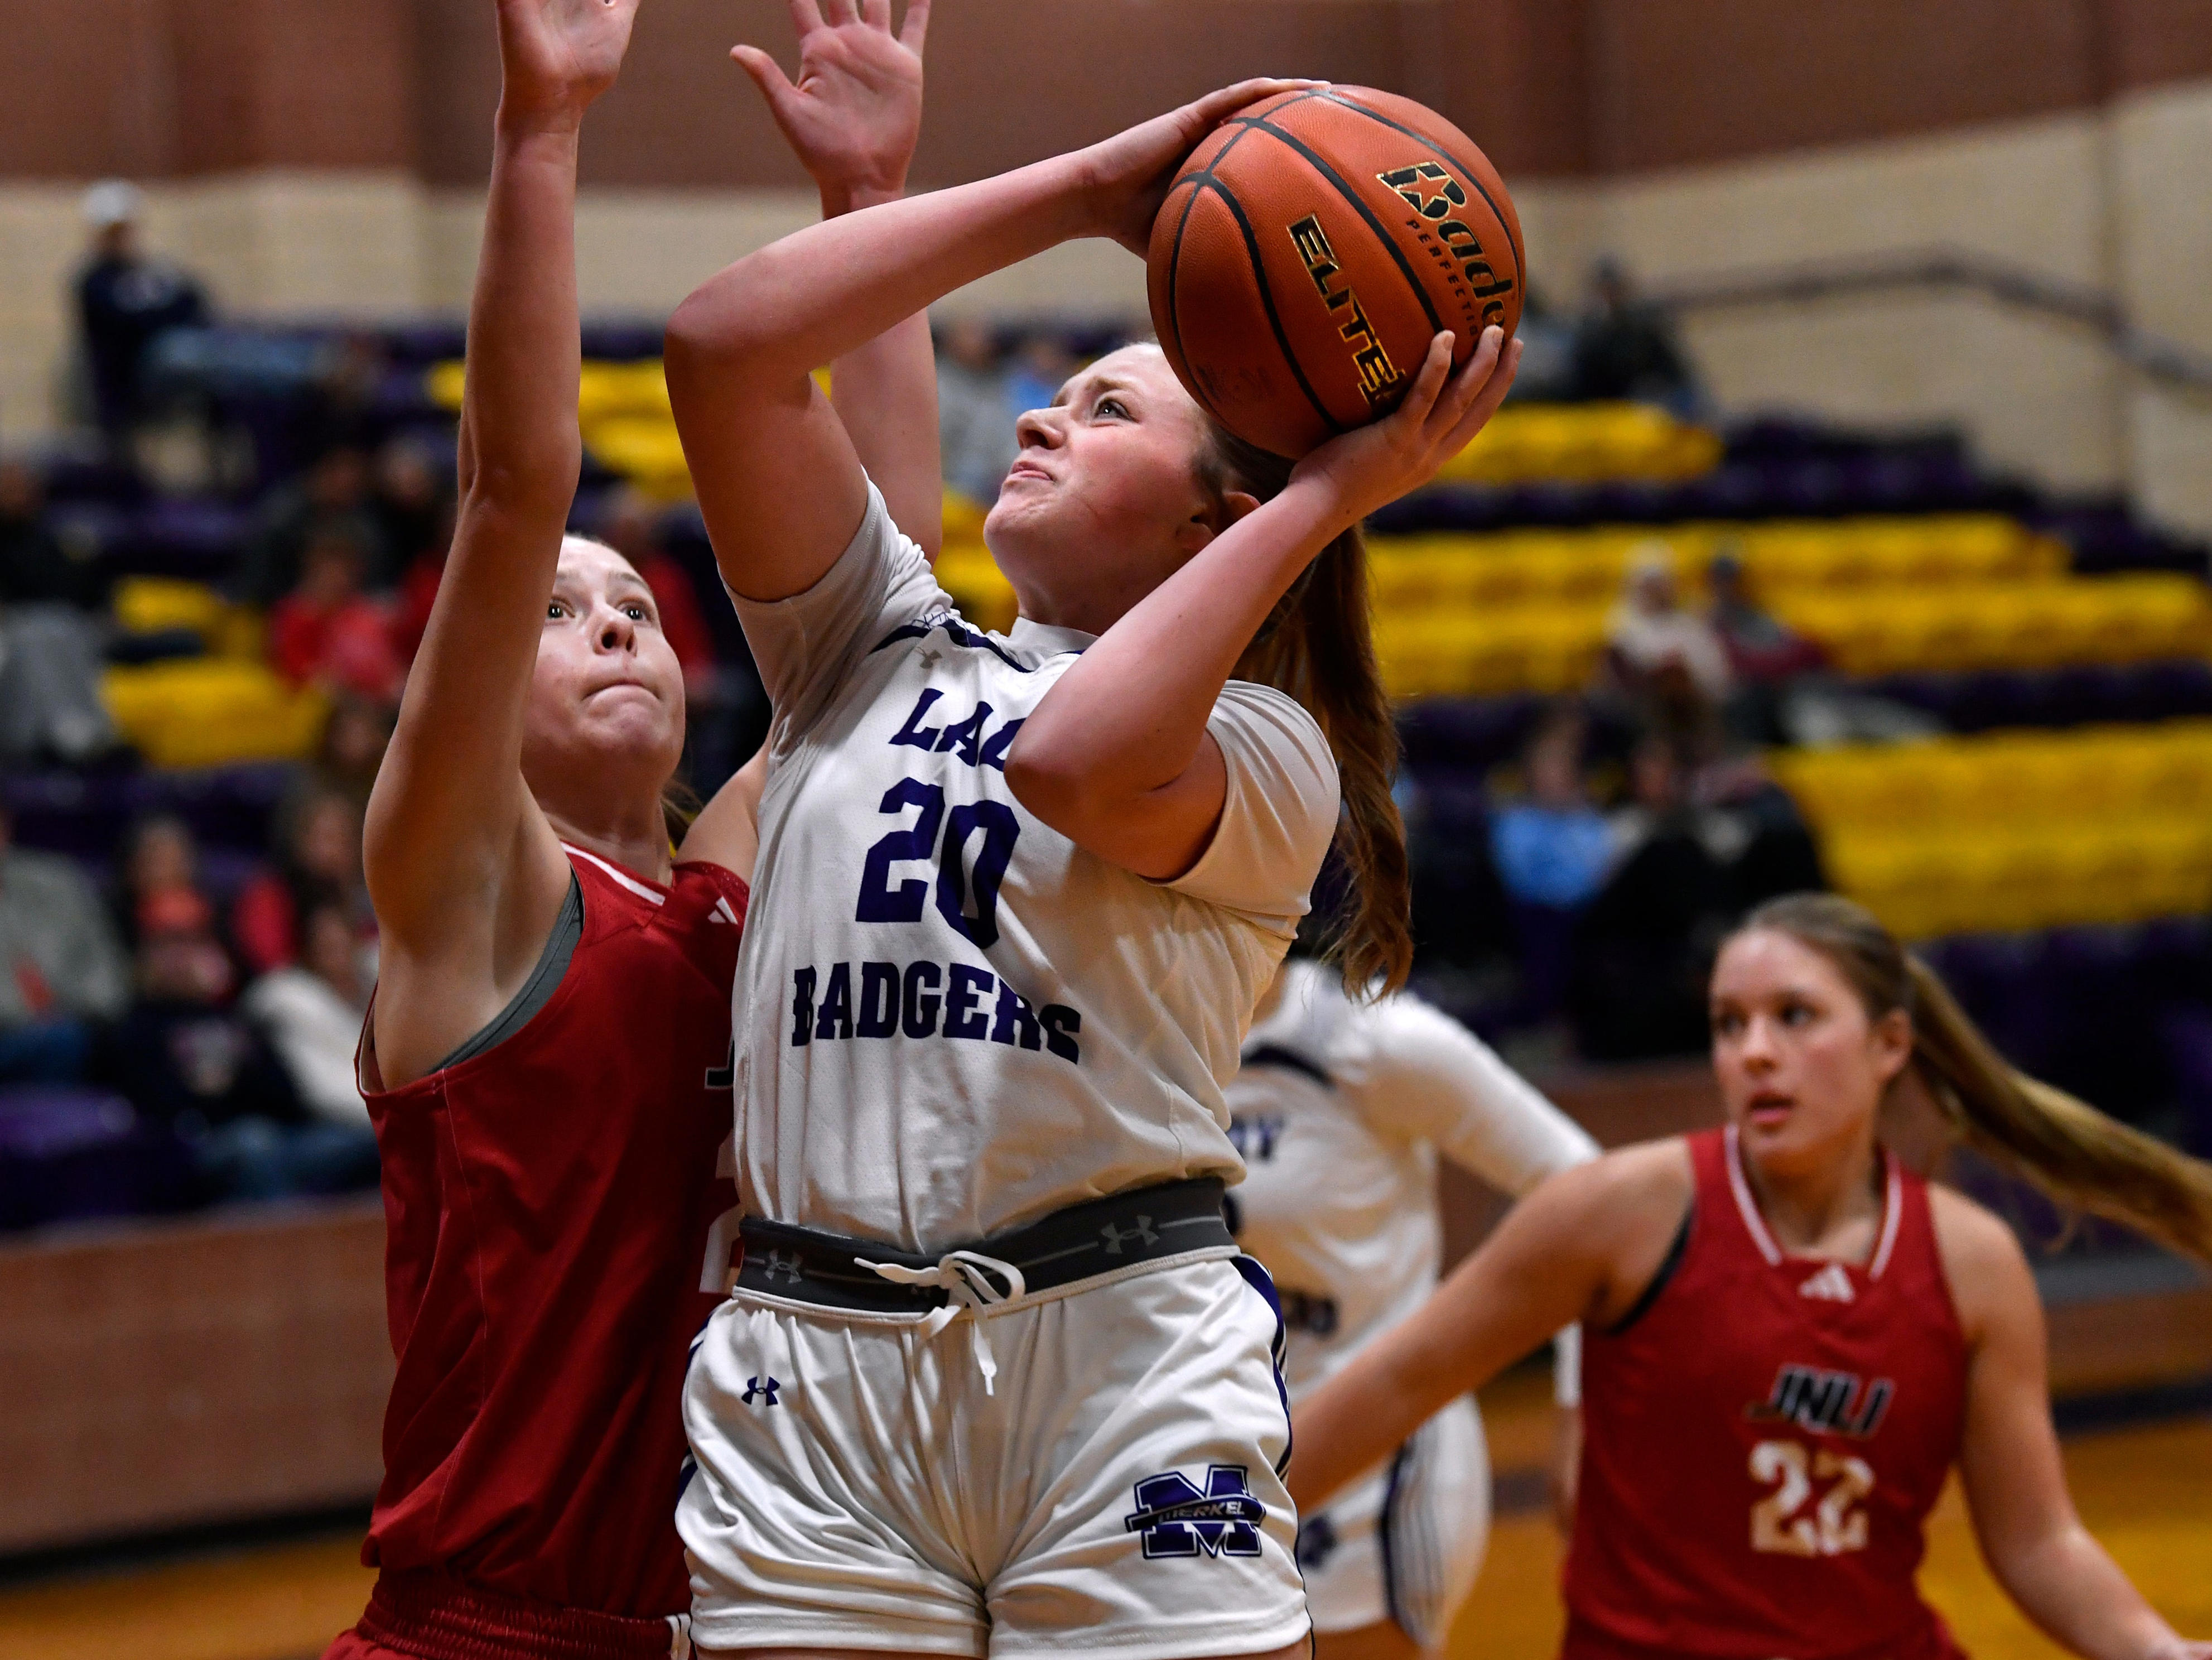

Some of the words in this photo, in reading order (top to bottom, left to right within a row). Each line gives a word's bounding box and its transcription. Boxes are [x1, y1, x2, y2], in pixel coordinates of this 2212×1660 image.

[1286, 213, 1399, 392] ELITE
[1376, 161, 1512, 329] Bade
[1406, 219, 1478, 336] PERFECTIO
[856, 777, 1020, 949] 20
[792, 960, 1082, 1065] BADGERS
[1158, 1501, 1245, 1523] MERKEL
[1747, 1438, 1877, 1557] 22
